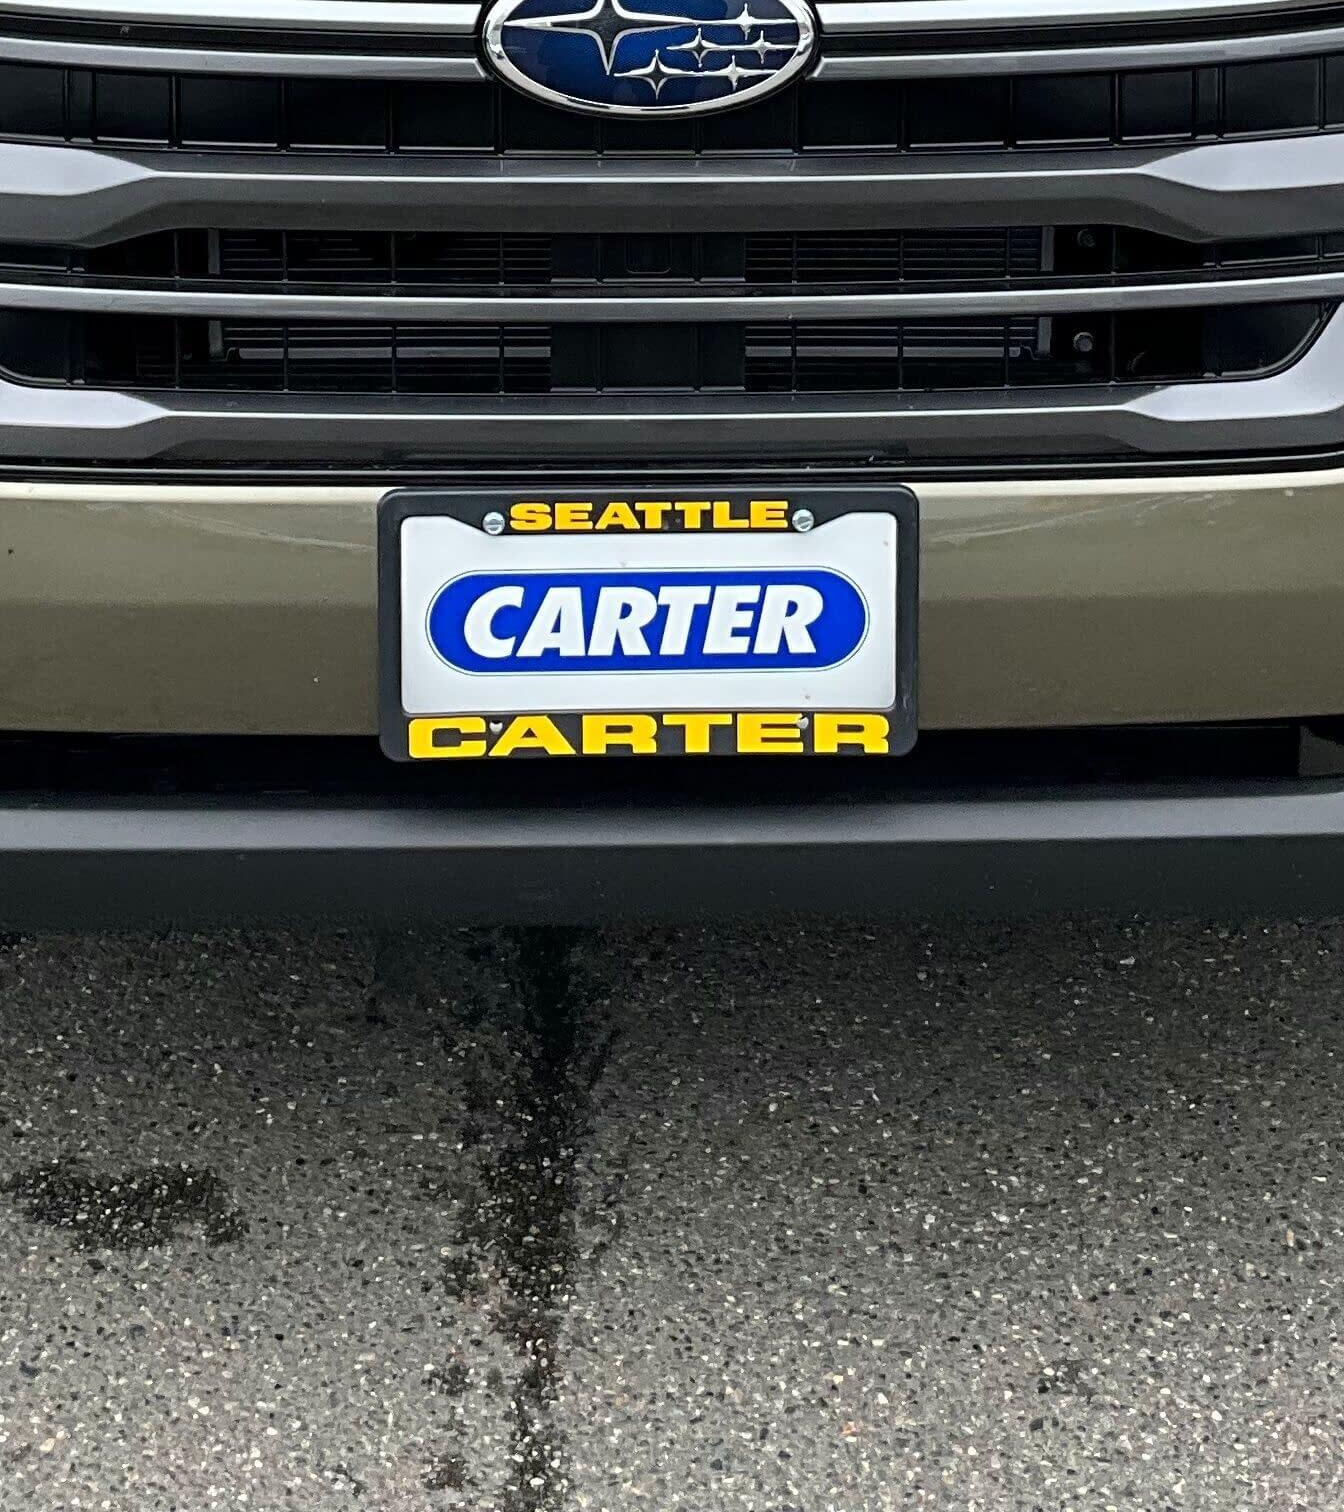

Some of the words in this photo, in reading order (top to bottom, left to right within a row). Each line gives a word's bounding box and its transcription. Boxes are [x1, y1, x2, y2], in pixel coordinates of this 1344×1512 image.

[510, 500, 788, 531] SEATTLE
[463, 584, 824, 658] CARTER
[408, 713, 890, 759] CARTER
